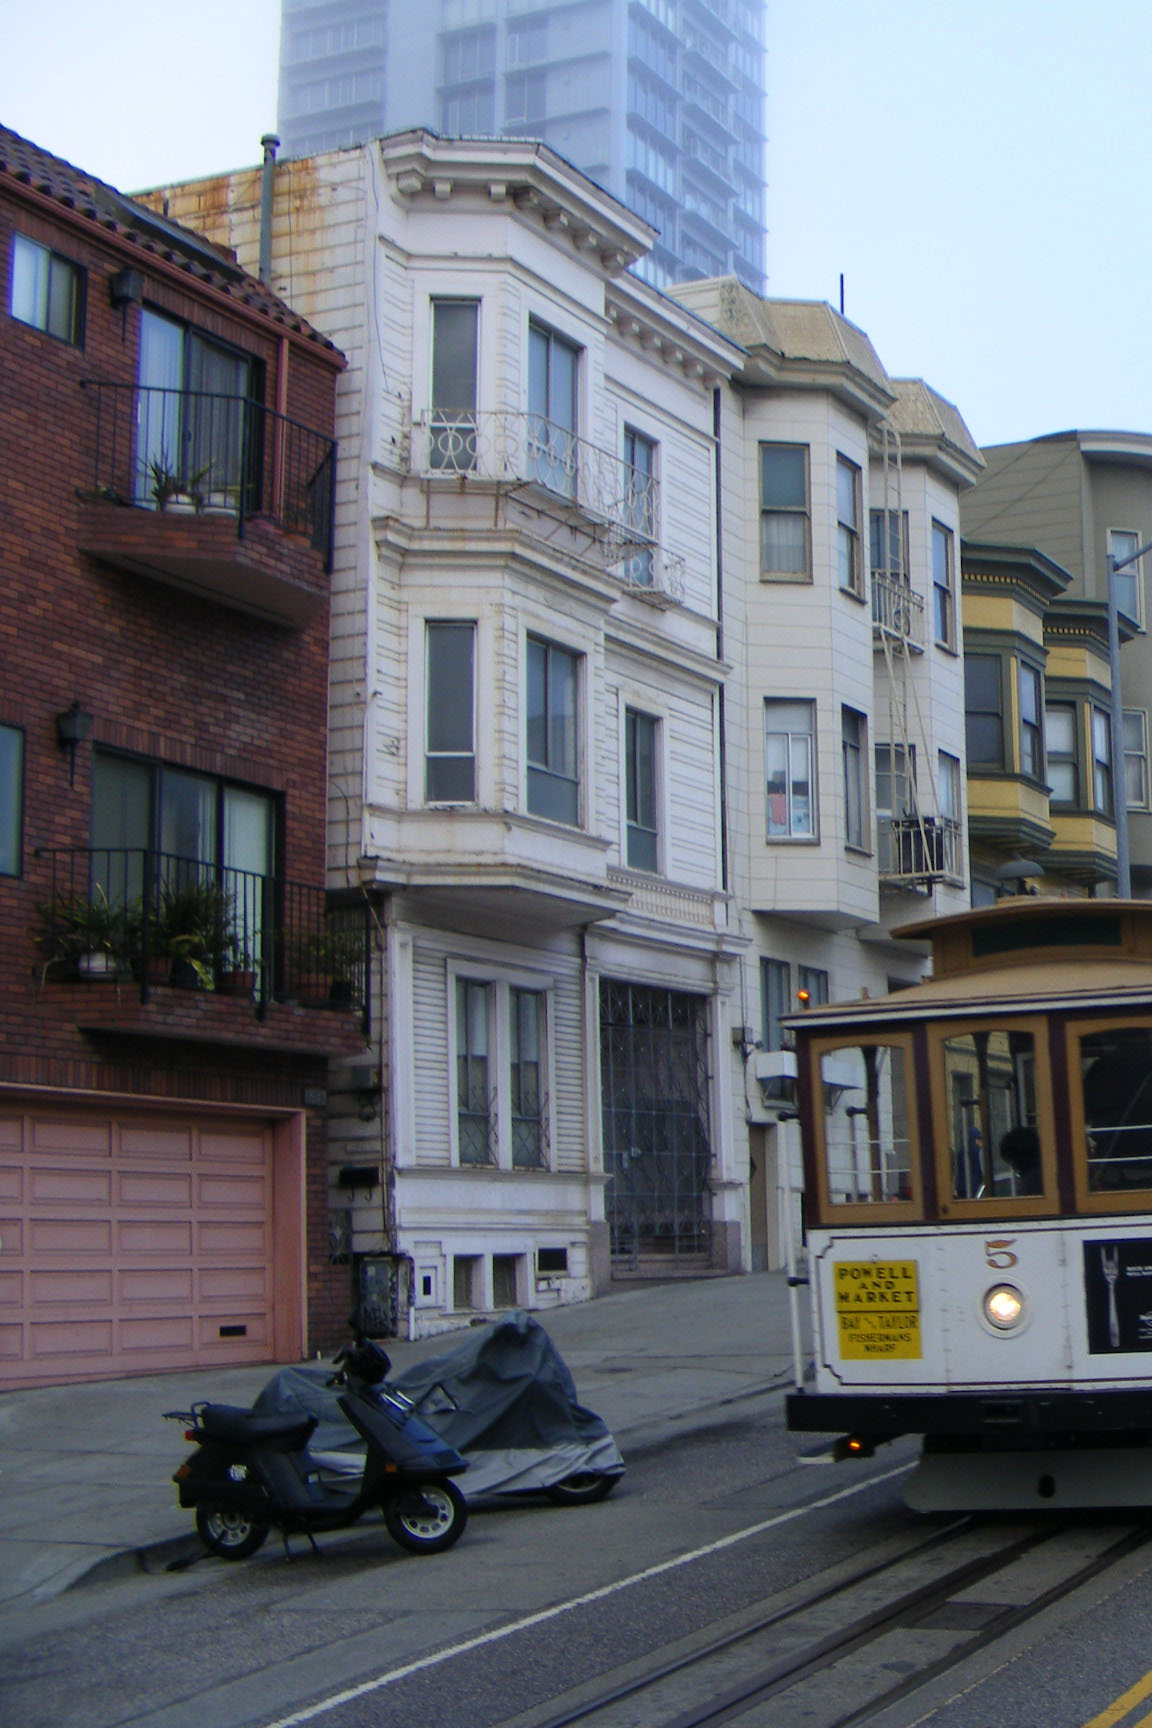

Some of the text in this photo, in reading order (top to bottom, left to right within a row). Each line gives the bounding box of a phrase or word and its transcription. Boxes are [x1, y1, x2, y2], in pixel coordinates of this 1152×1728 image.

[984, 1239, 1018, 1269] 5
[838, 1267, 912, 1280] POWELL
[860, 1281, 895, 1290] AND
[838, 1291, 914, 1302] MARKET
